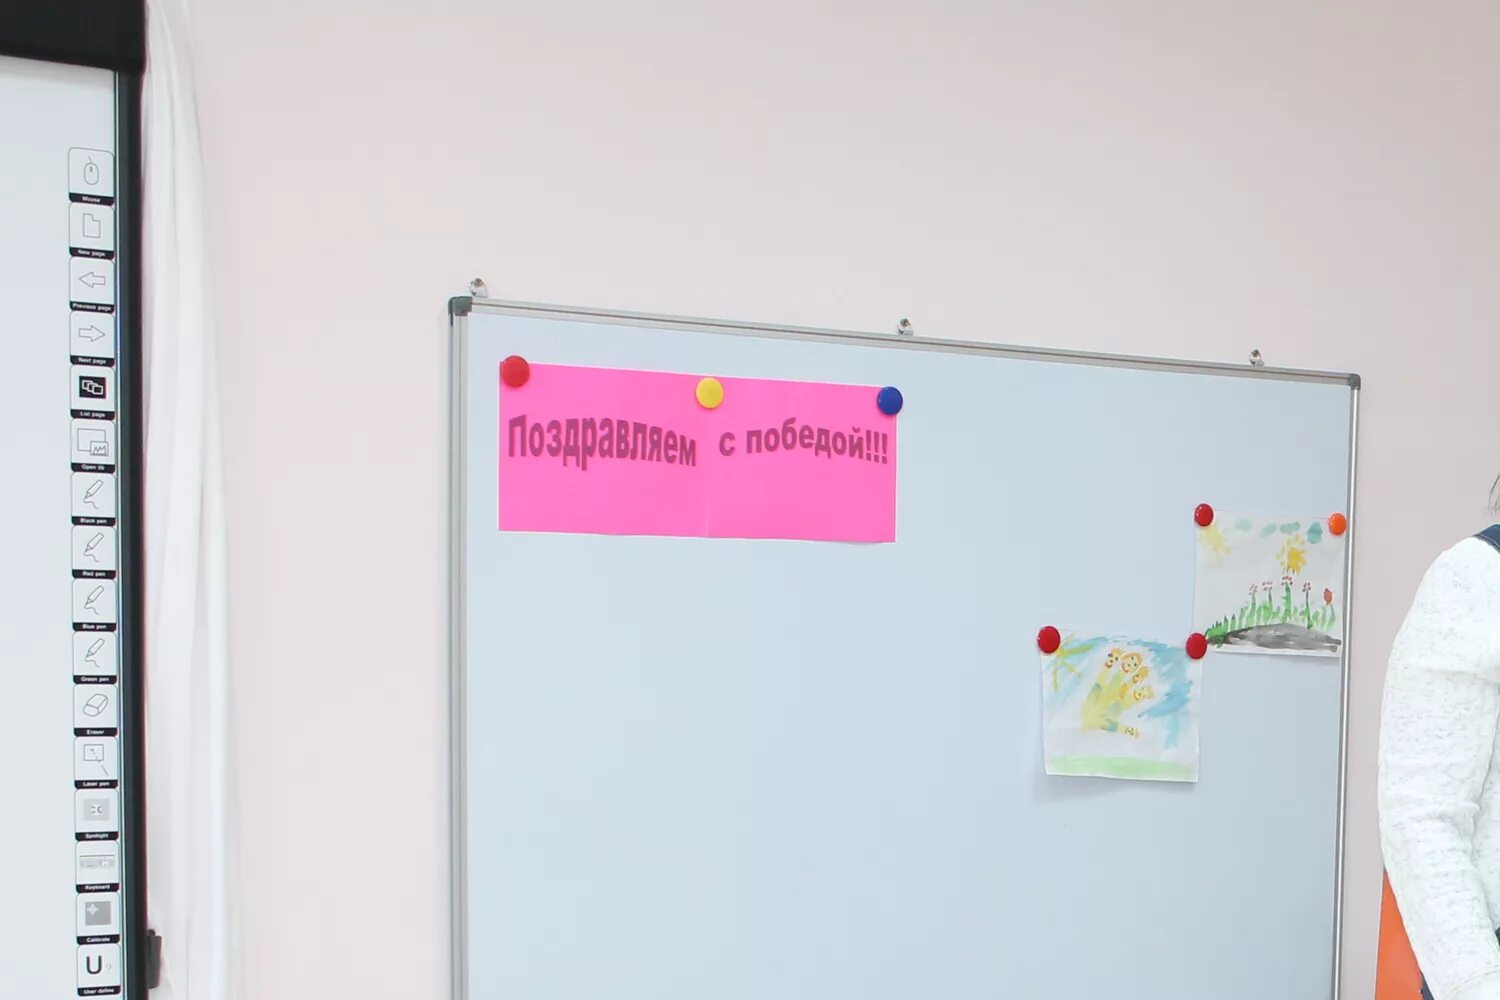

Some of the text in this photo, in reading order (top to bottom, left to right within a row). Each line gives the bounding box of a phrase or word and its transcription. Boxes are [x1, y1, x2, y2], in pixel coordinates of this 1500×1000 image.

[508, 414, 888, 471] Поздравляем с победой!!!
